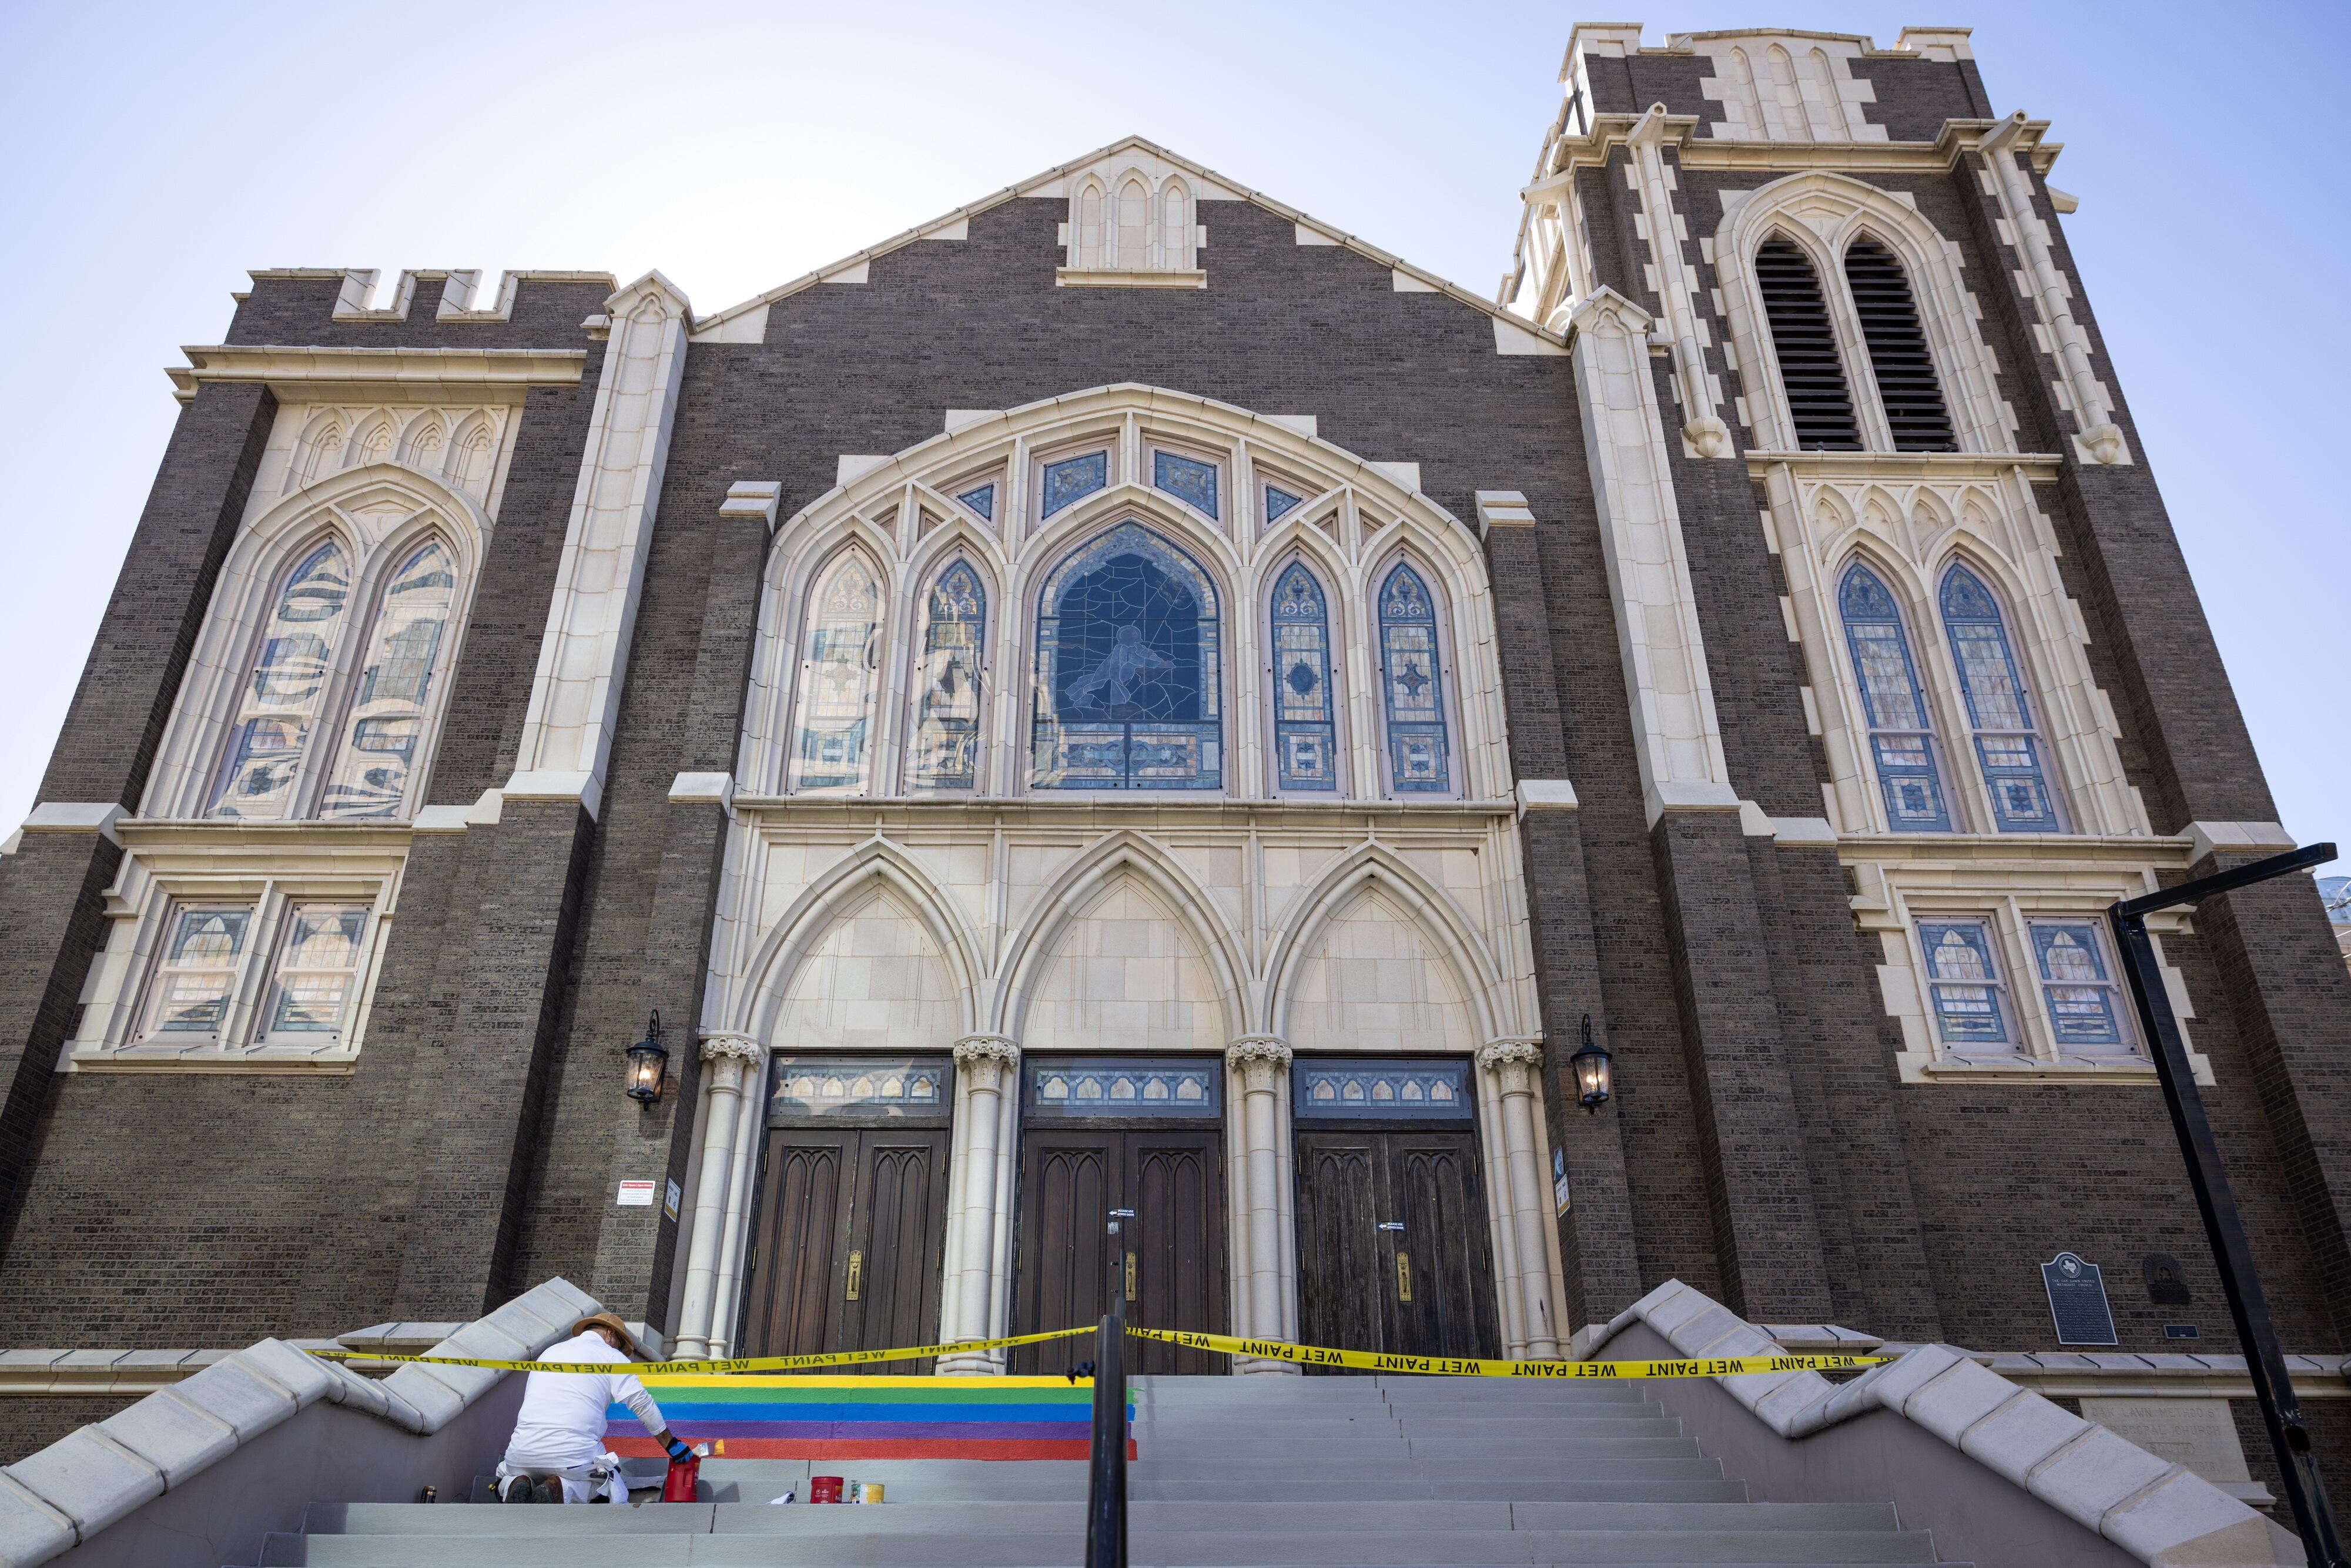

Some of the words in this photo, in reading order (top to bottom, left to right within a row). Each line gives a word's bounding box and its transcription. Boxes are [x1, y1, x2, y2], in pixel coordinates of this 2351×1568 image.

[1170, 1333, 1210, 1348] WET
[1239, 1341, 1293, 1359] PAINT
[1301, 1349, 1344, 1364] WET
[1374, 1356, 1429, 1371] PAINT
[1438, 1361, 1481, 1374] WET
[1706, 1360, 1744, 1374] WET
[1770, 1357, 1817, 1371] PAINT
[1823, 1356, 1856, 1367] WET
[1511, 1363, 1567, 1376] PAINT
[1575, 1365, 1617, 1376] WET
[1646, 1362, 1699, 1376] PAINT
[2092, 1408, 2114, 1417] OAK
[2121, 1408, 2152, 1417] LAWN
[2158, 1408, 2220, 1418] METHODIST
[2105, 1426, 2167, 1435] PISCOPAL
[2175, 1426, 2219, 1435] CHURCH
